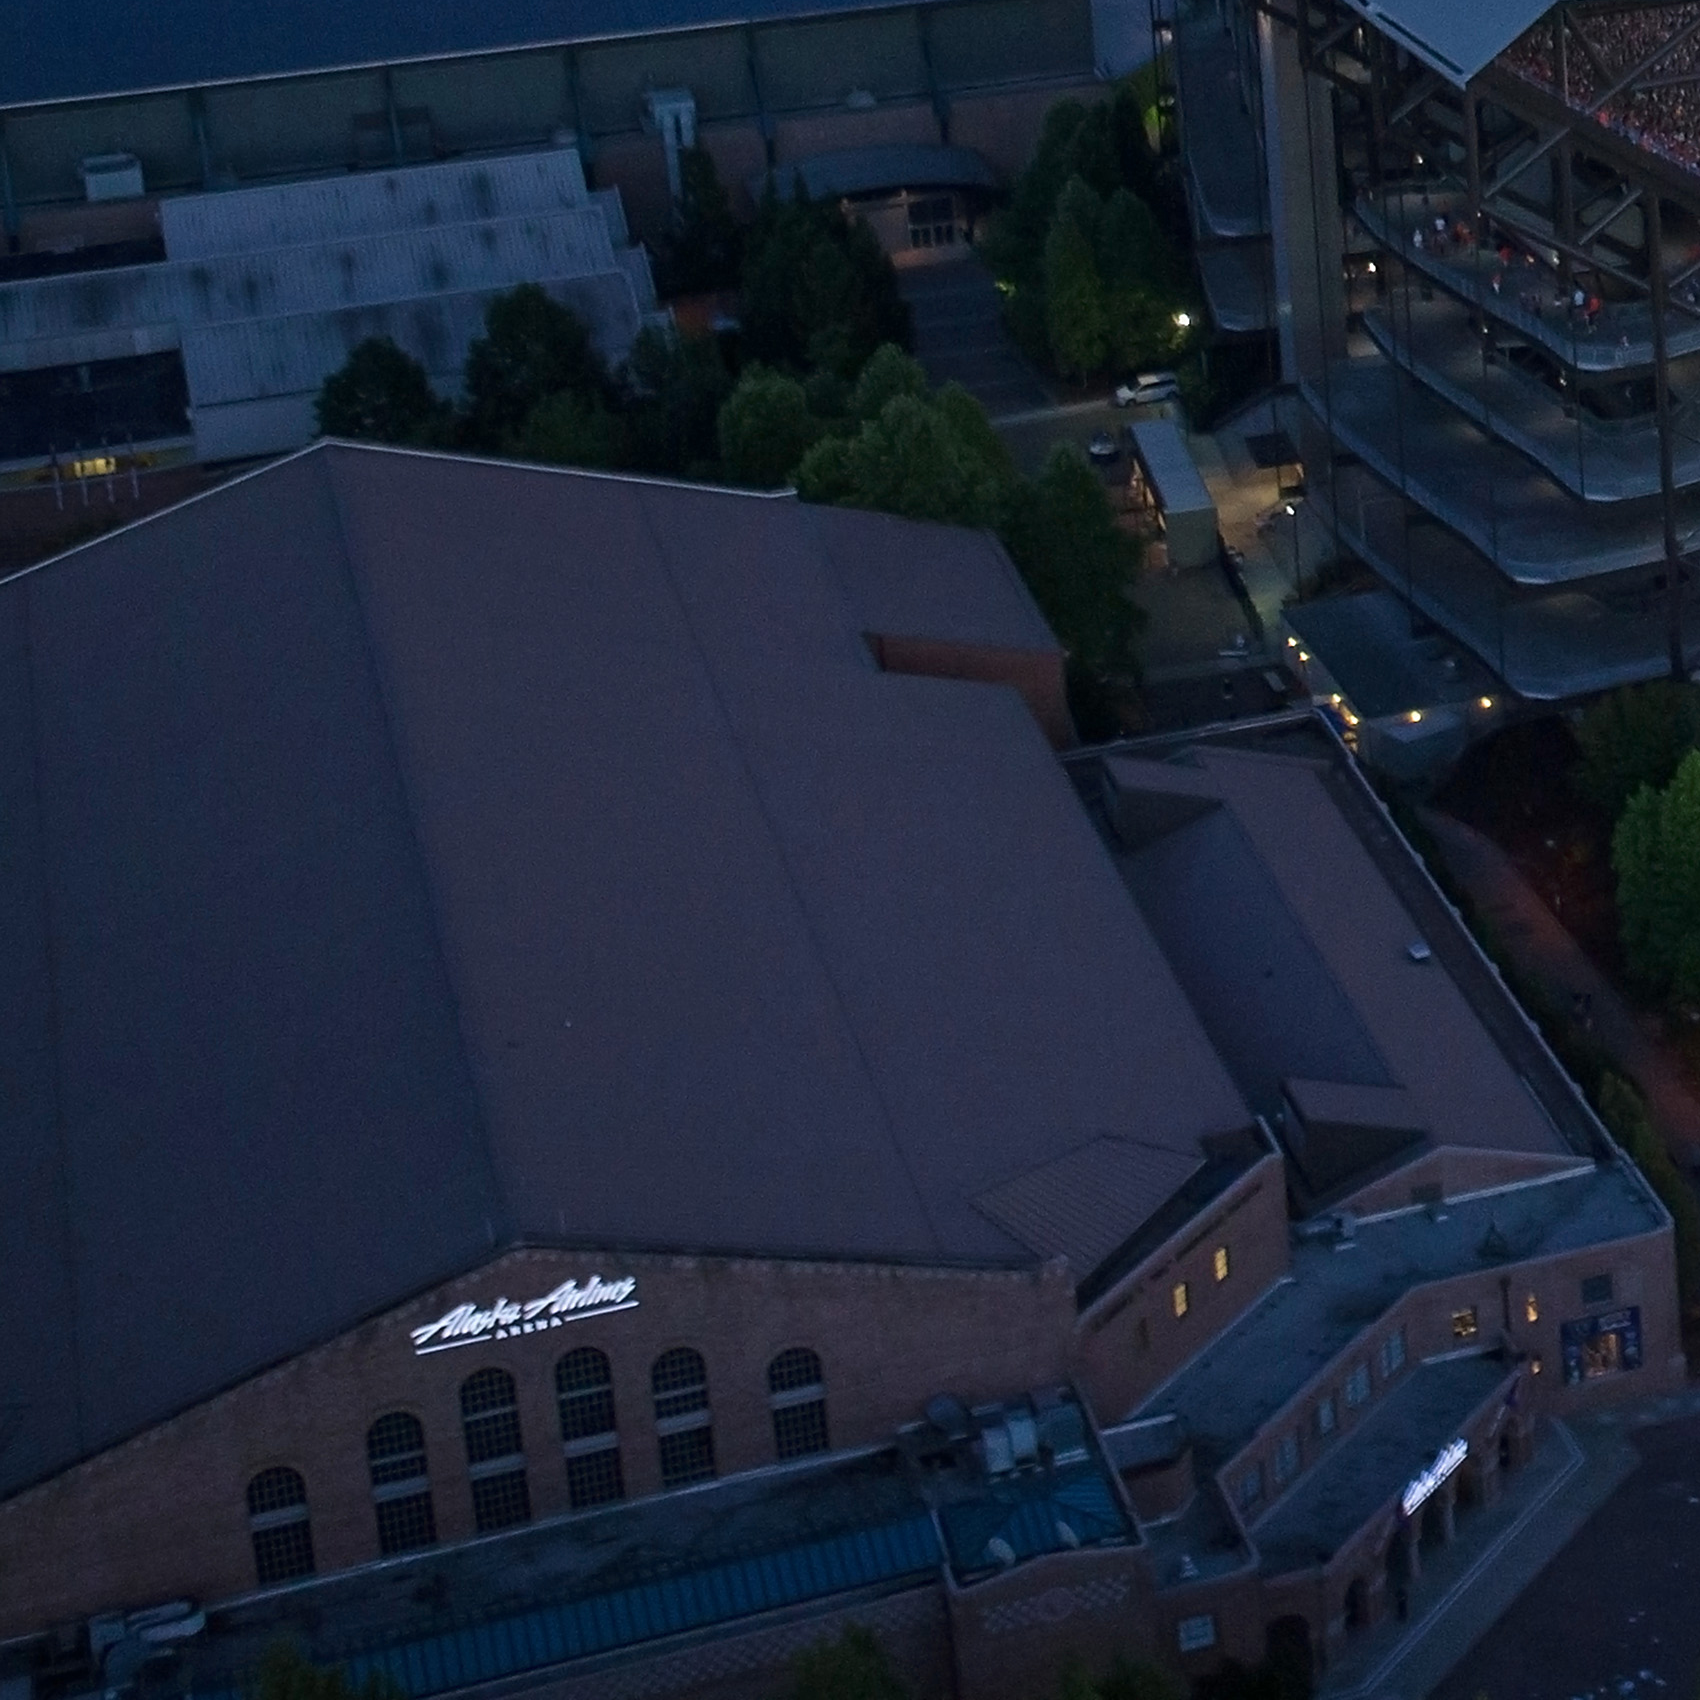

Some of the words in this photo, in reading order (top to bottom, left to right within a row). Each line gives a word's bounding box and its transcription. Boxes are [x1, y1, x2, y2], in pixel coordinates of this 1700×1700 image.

[410, 1297, 522, 1346] Alaska
[523, 1274, 637, 1321] Airlines
[495, 1317, 563, 1340] ARENA
